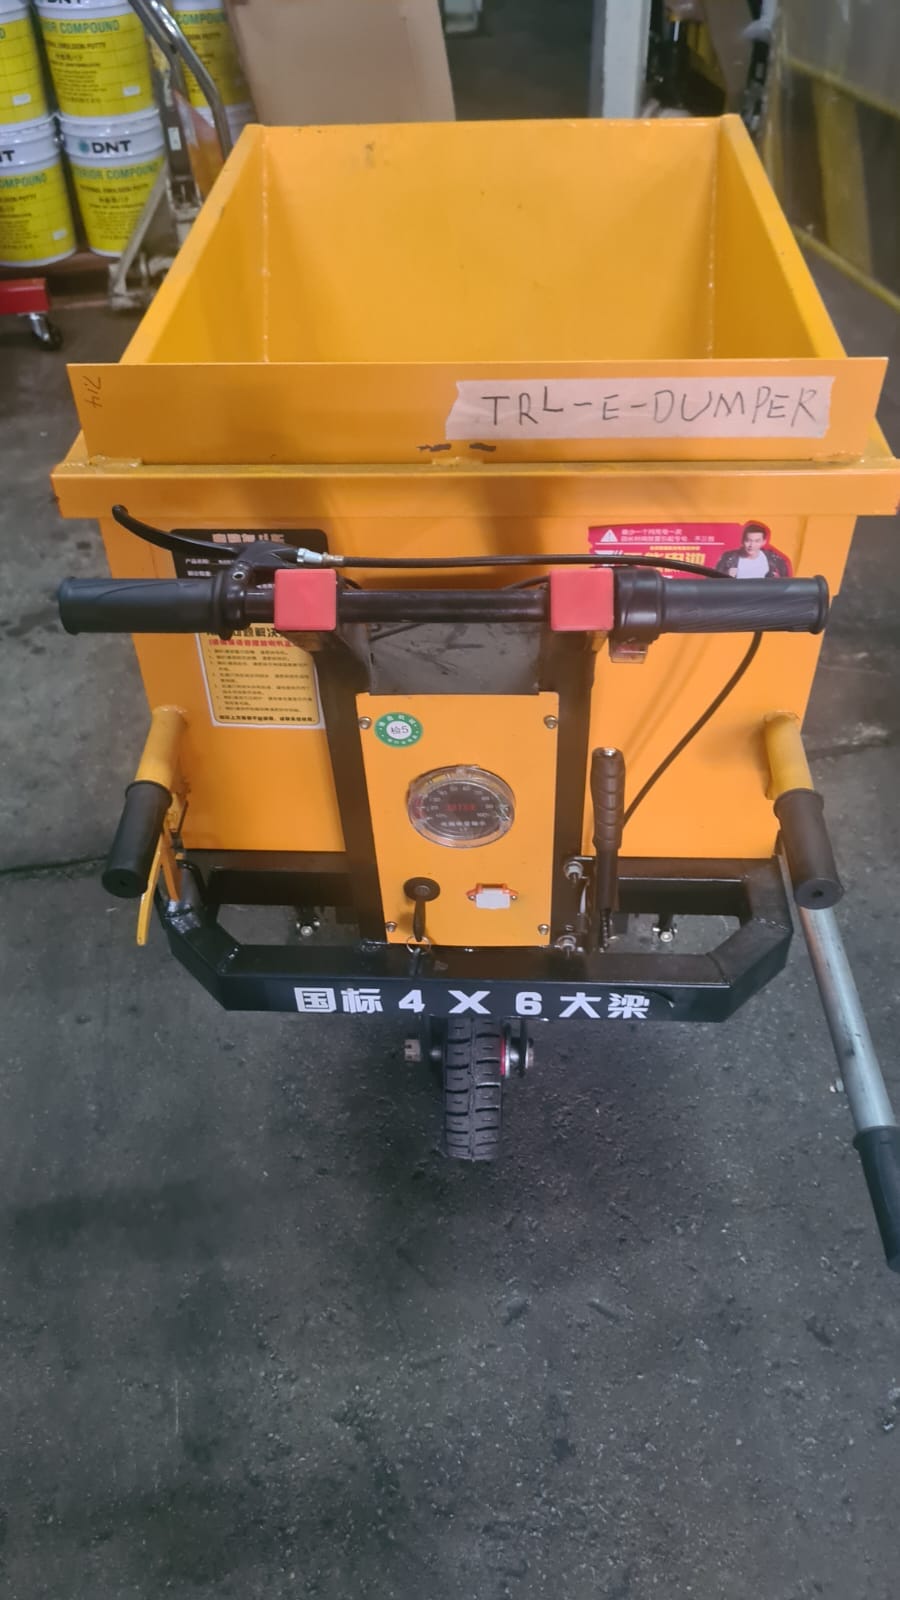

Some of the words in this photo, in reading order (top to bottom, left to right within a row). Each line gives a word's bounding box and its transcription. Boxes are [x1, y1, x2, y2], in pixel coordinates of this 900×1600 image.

[60, 19, 120, 34] COMPOUND
[91, 140, 132, 154] DNT
[0, 172, 47, 188] OMPOUND
[482, 386, 818, 426] TRL-E-DUMPER
[294, 987, 384, 1013] 国标
[398, 990, 425, 1012] 4
[515, 991, 542, 1016] 6
[559, 992, 650, 1019] 大梁
